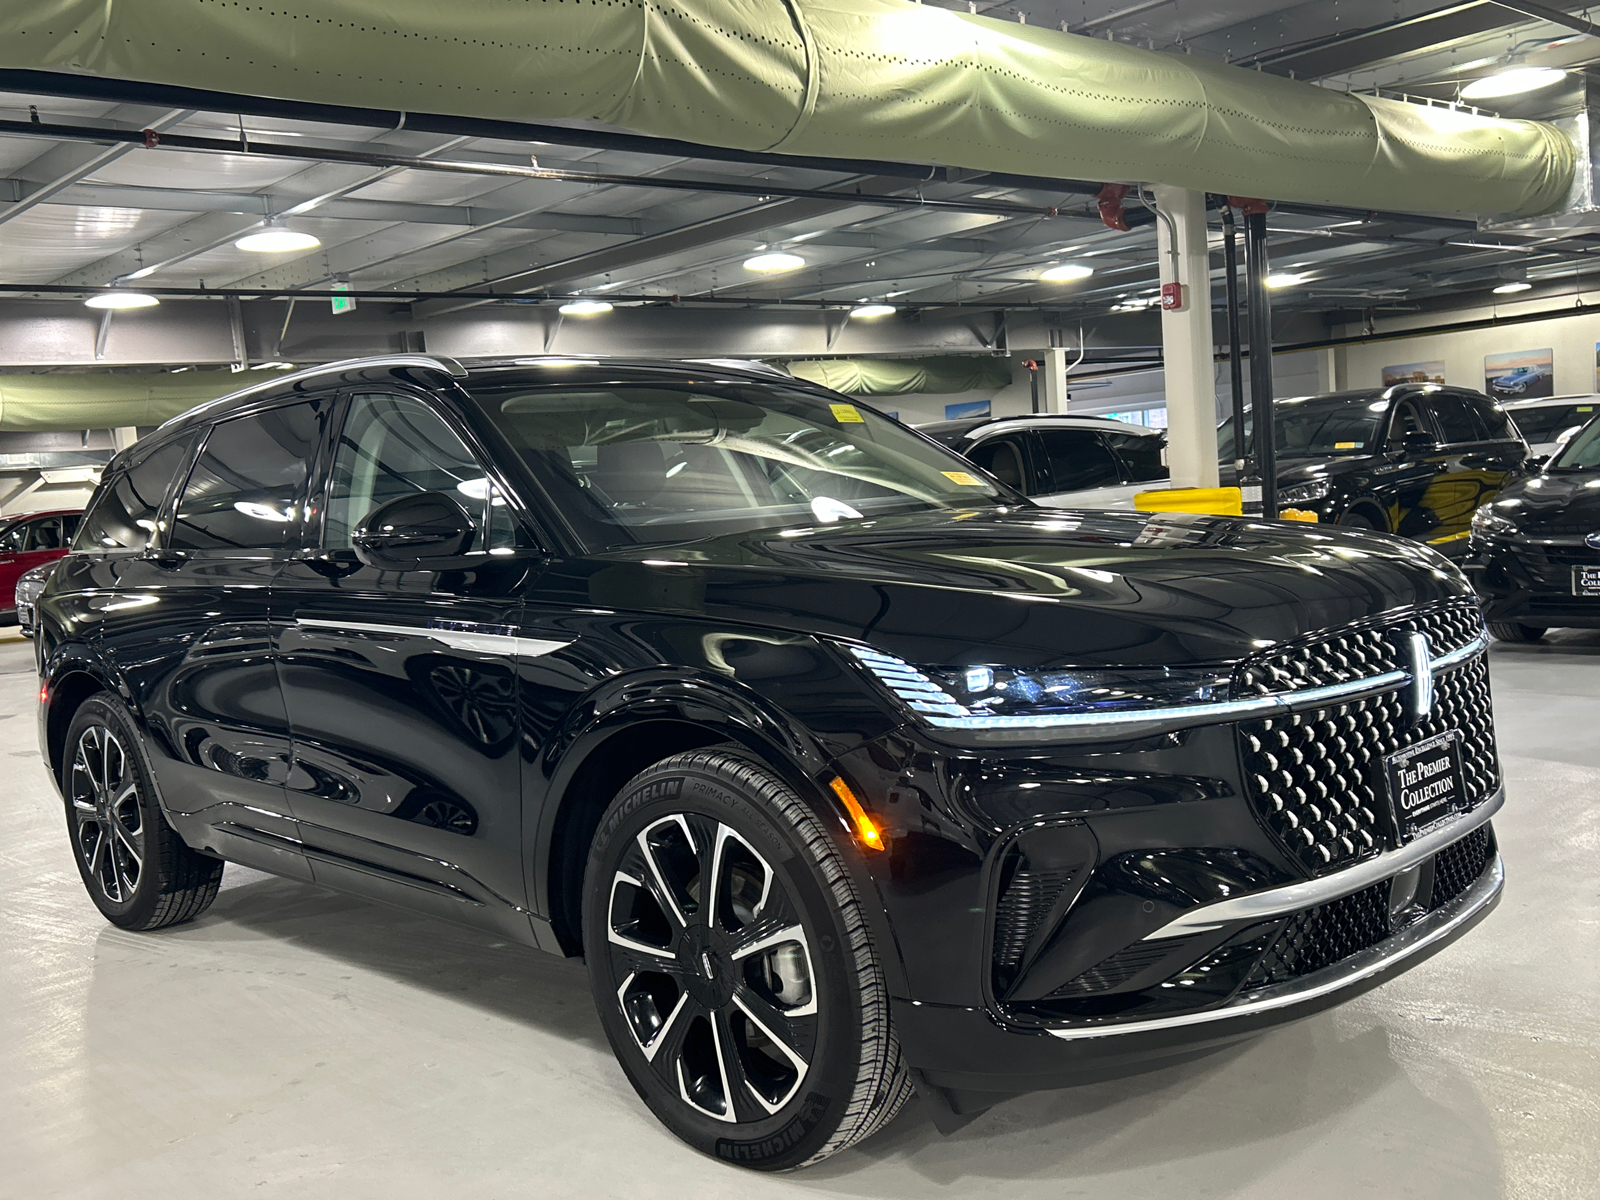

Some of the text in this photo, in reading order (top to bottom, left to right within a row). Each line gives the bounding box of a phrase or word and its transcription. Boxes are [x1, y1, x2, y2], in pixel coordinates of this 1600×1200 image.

[1397, 756, 1452, 789] THE PREMIER
[608, 780, 681, 834] MICHELIN
[1400, 775, 1455, 810] COLLECTION
[692, 782, 784, 851] PRIMACY ALL SEASON
[719, 1121, 807, 1160] MICHELIN
